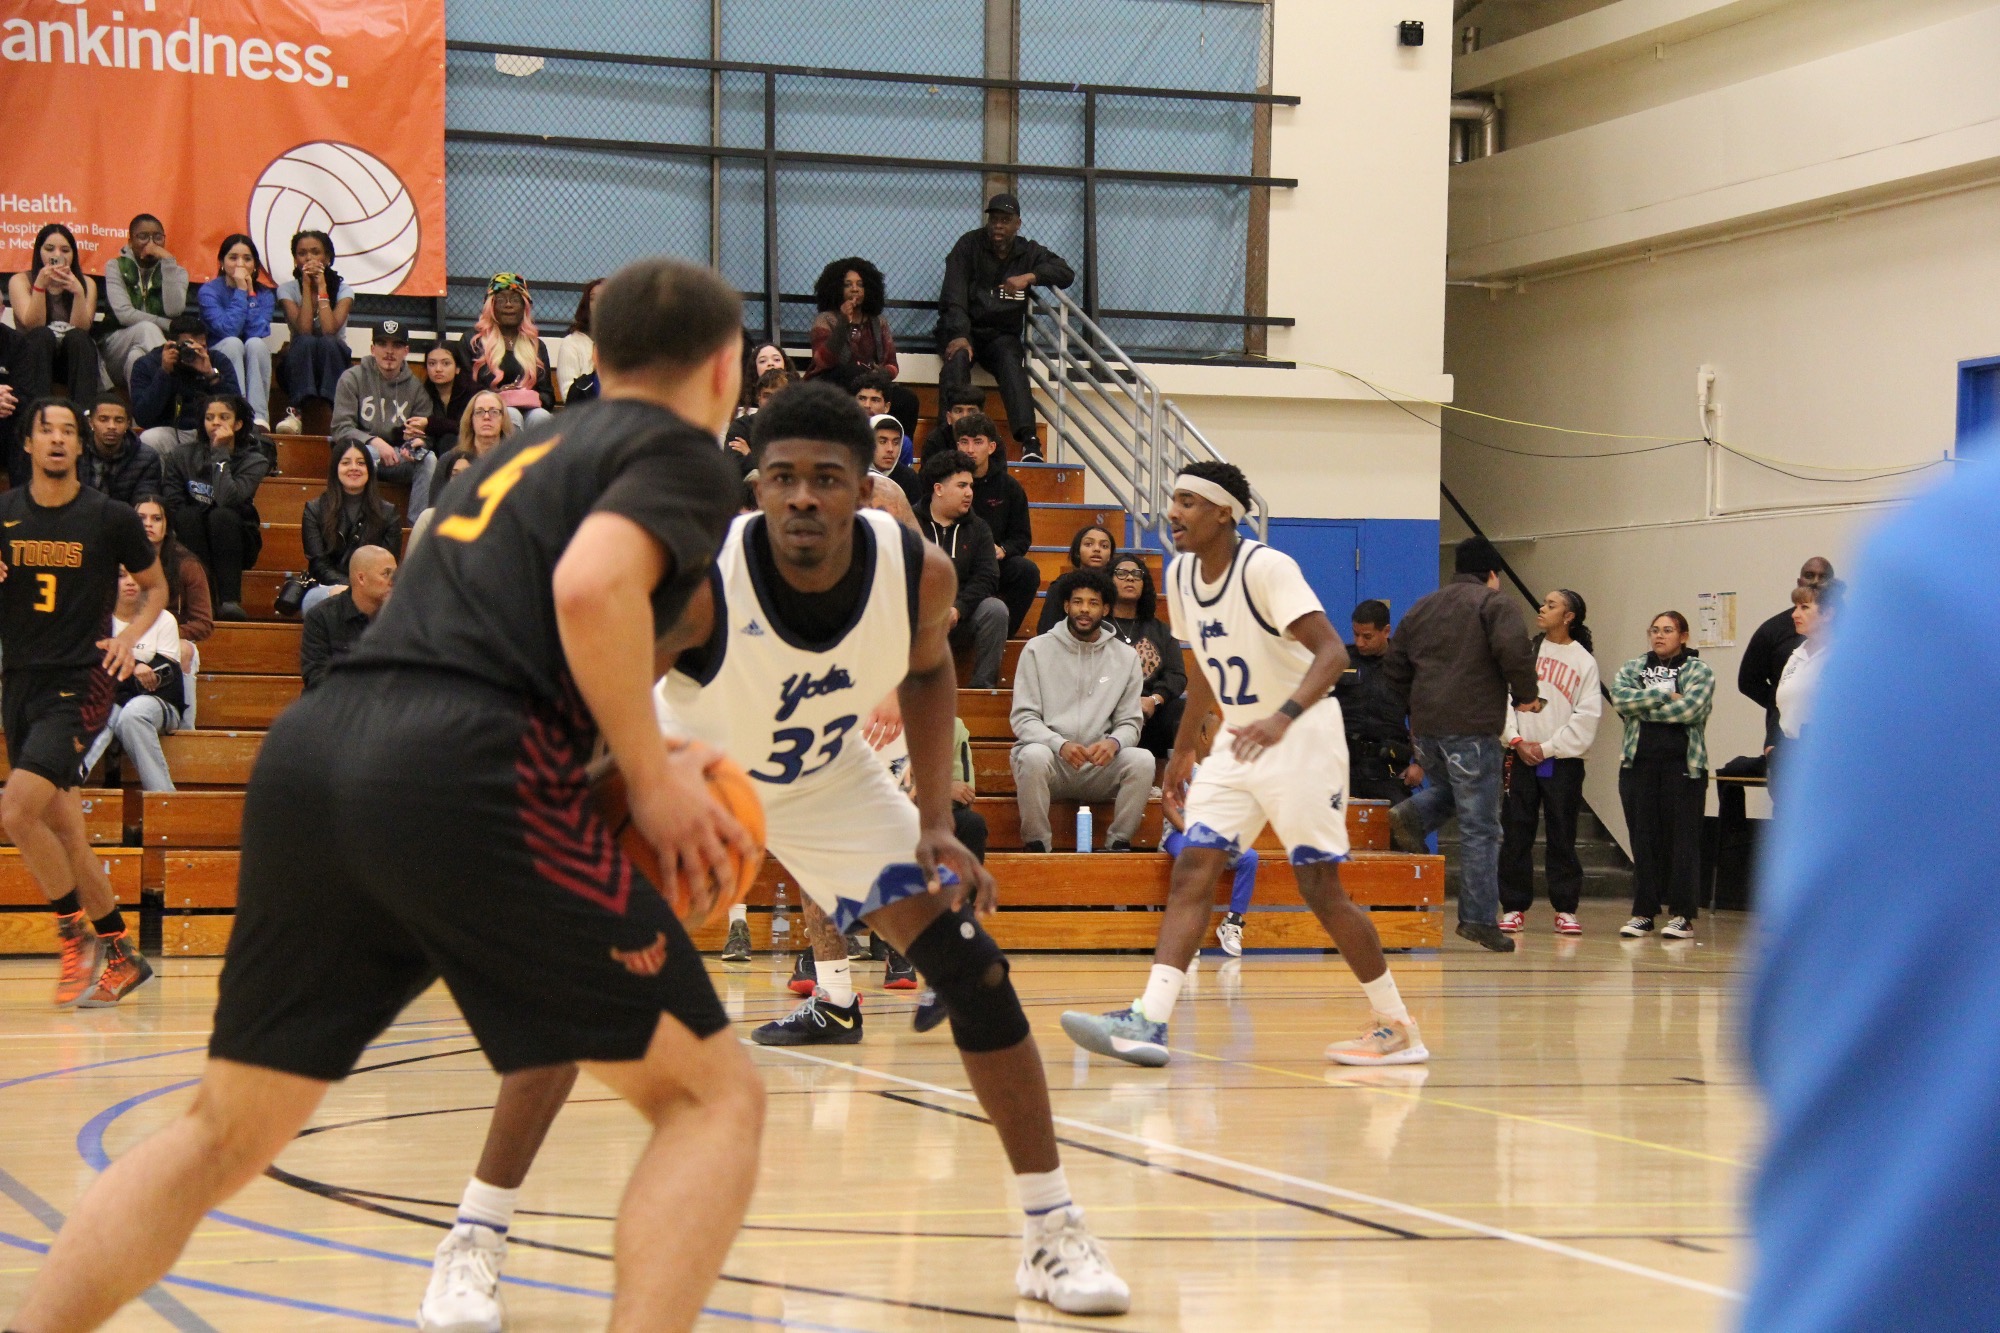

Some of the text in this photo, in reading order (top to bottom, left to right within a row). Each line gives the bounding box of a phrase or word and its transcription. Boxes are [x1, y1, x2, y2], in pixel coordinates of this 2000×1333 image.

[9, 540, 84, 568] TOROS
[33, 573, 57, 613] 3
[1207, 656, 1259, 706] 22
[747, 714, 858, 785] 33
[81, 799, 93, 814] 2
[1358, 810, 1369, 823] 2
[1414, 865, 1421, 879] 1
